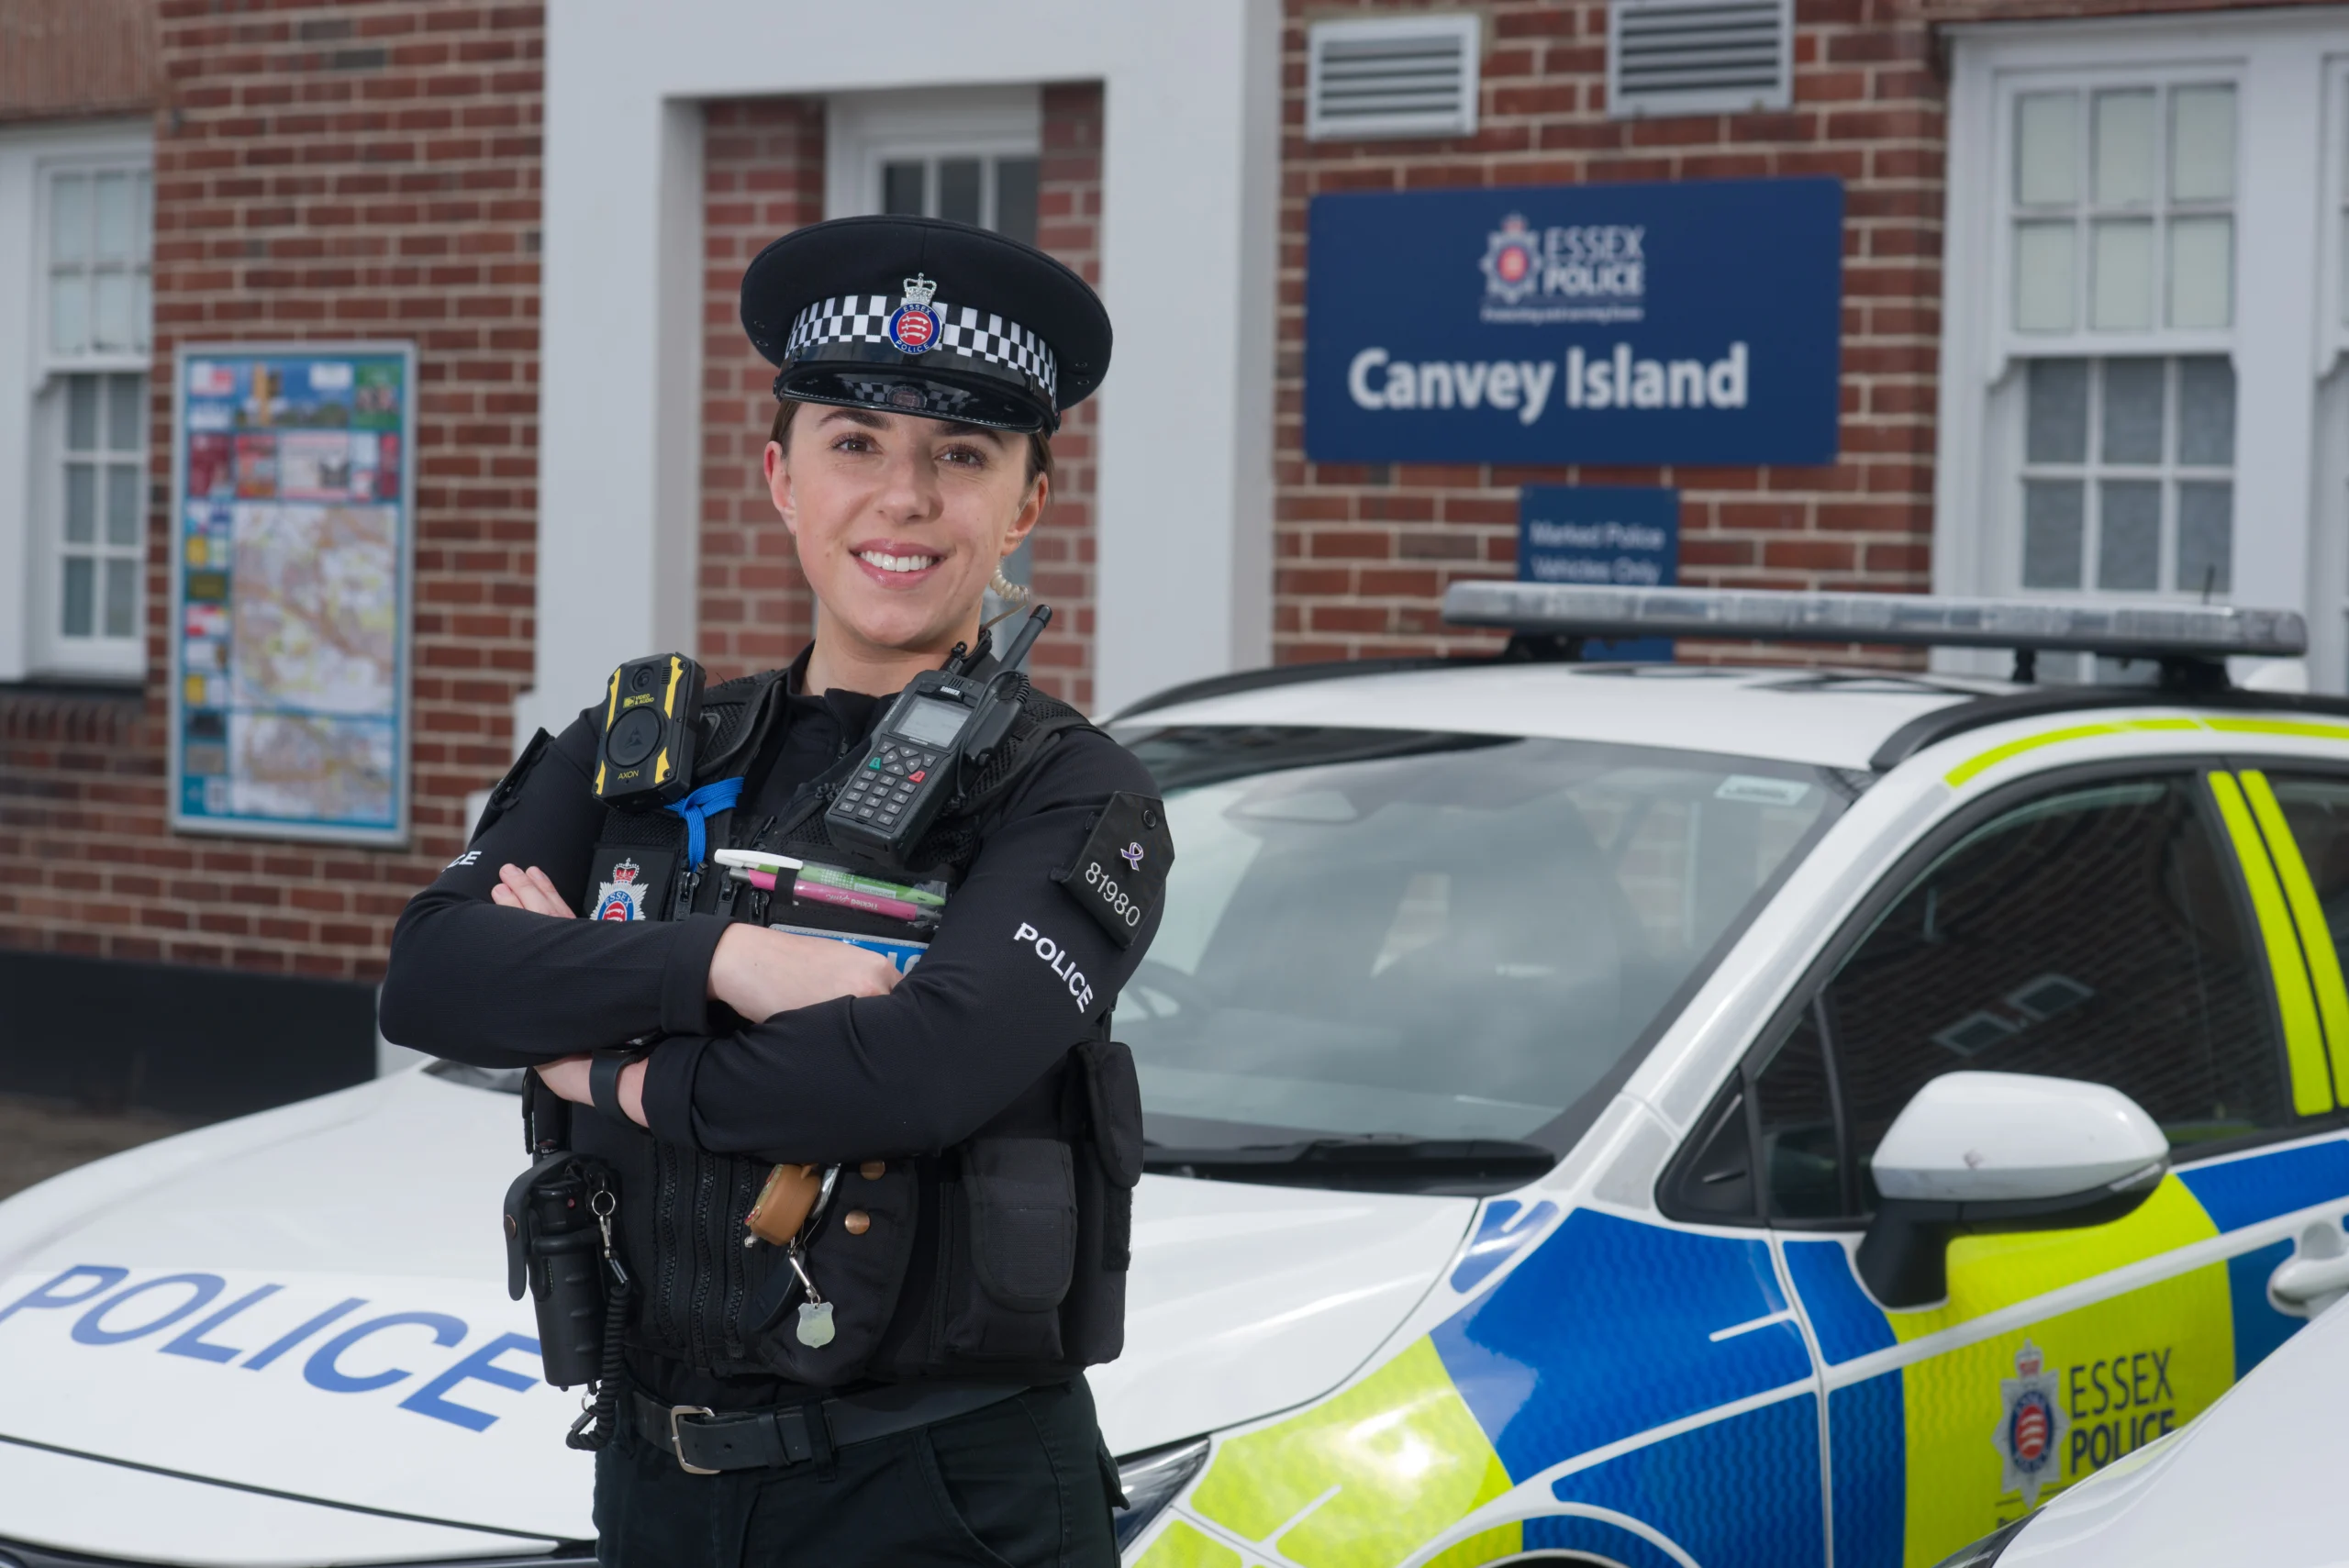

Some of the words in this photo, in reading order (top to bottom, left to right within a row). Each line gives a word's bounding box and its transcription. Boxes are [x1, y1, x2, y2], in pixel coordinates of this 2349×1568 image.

[1544, 226, 1646, 262] ESSEX
[1542, 261, 1645, 295] POLICE
[903, 304, 932, 316] ESSEX
[896, 339, 930, 353] POLICE
[1348, 347, 1556, 426] Canvey
[1566, 341, 1749, 408] Island
[618, 770, 640, 780] AXON
[606, 891, 632, 907] ESSEX
[851, 898, 878, 911] Tickled
[1085, 862, 1141, 927] 81980
[1013, 922, 1093, 1013] POLICE
[0, 1263, 542, 1433] POLICE
[2070, 1347, 2175, 1419] ESSEX
